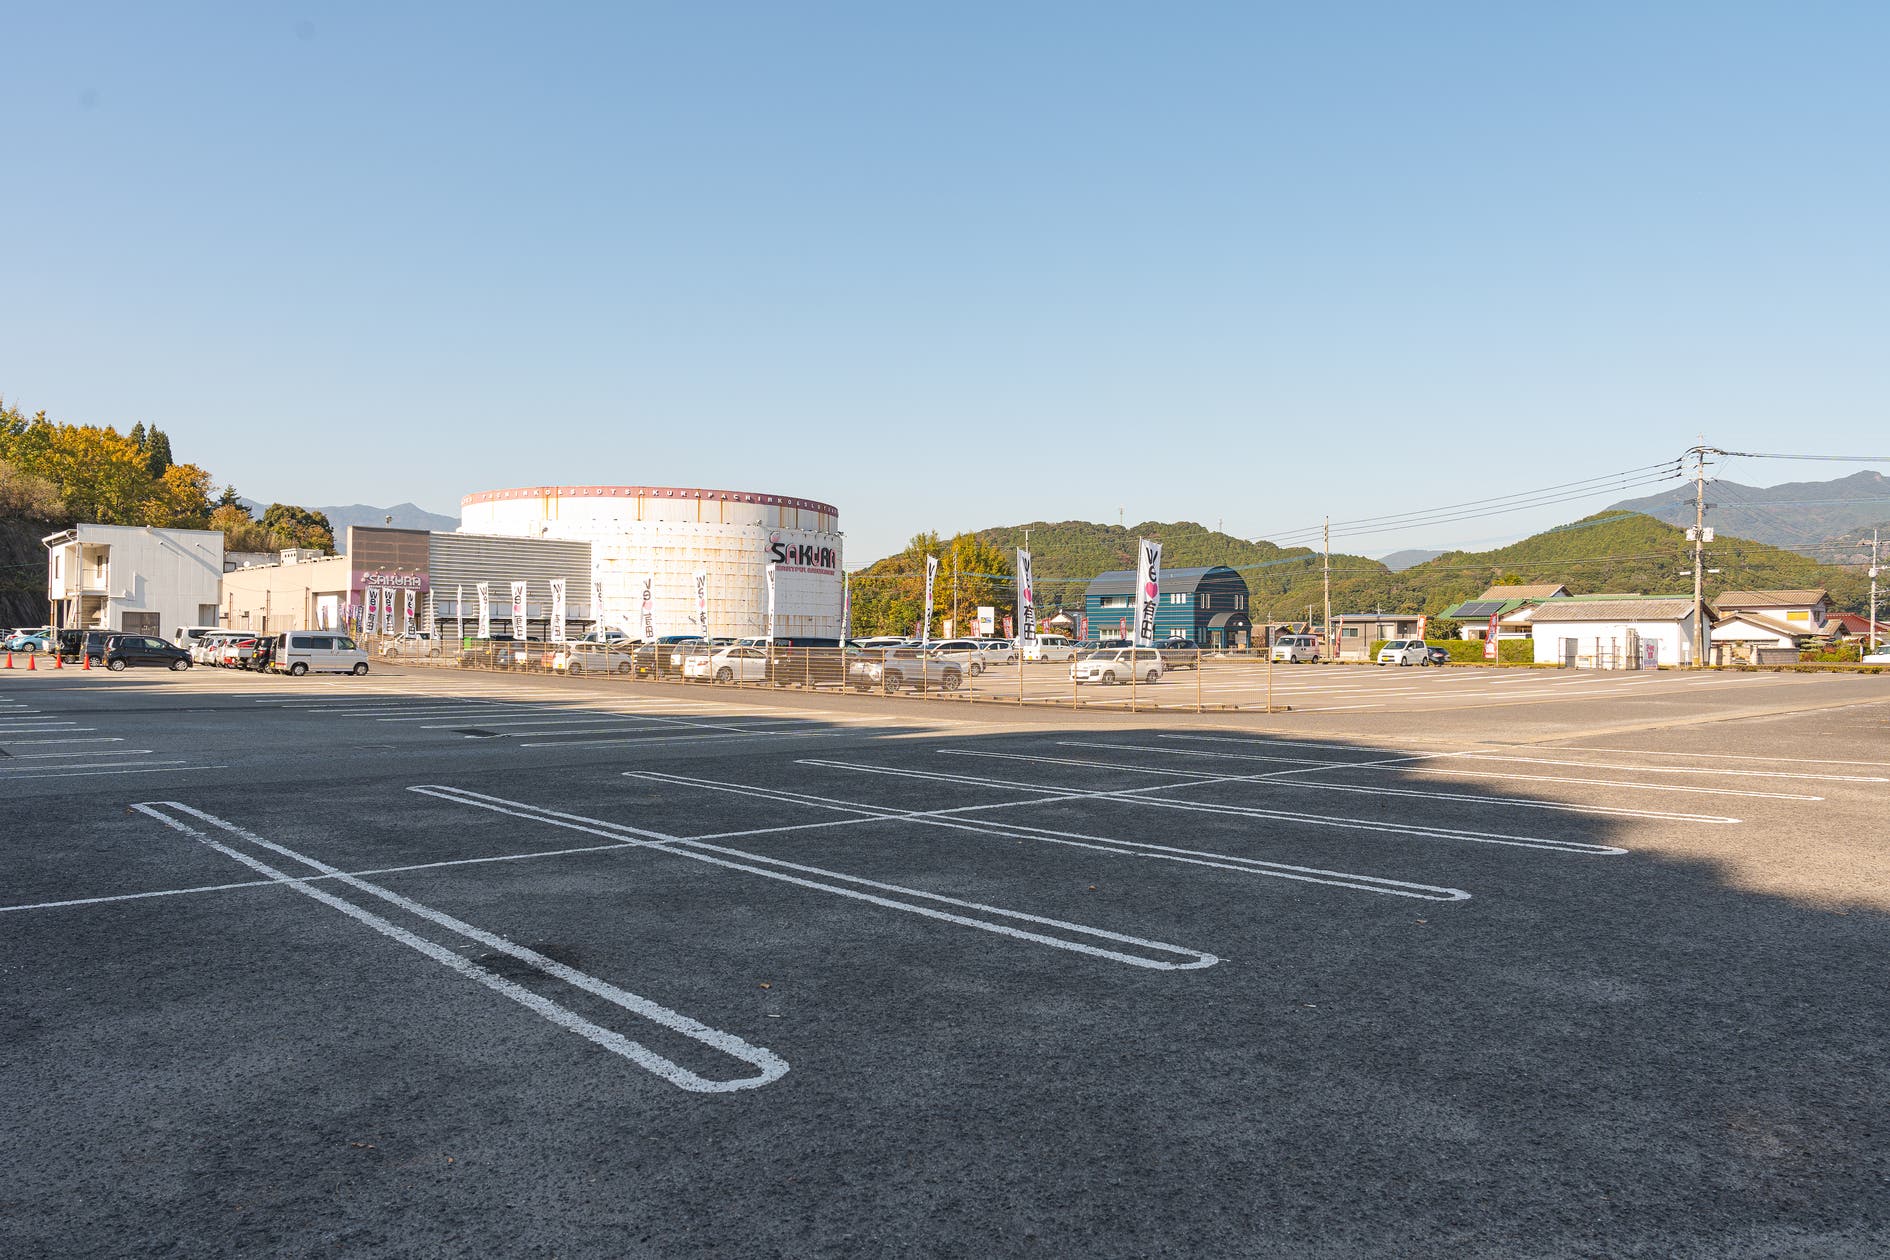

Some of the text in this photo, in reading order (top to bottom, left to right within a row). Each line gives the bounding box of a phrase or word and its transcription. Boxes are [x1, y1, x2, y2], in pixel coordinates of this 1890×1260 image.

[771, 542, 836, 568] SAKURA
[1146, 547, 1158, 582] We
[368, 575, 421, 586] SAKURA
[369, 590, 377, 605] We
[385, 590, 393, 606] We
[1141, 600, 1156, 640] 有田
